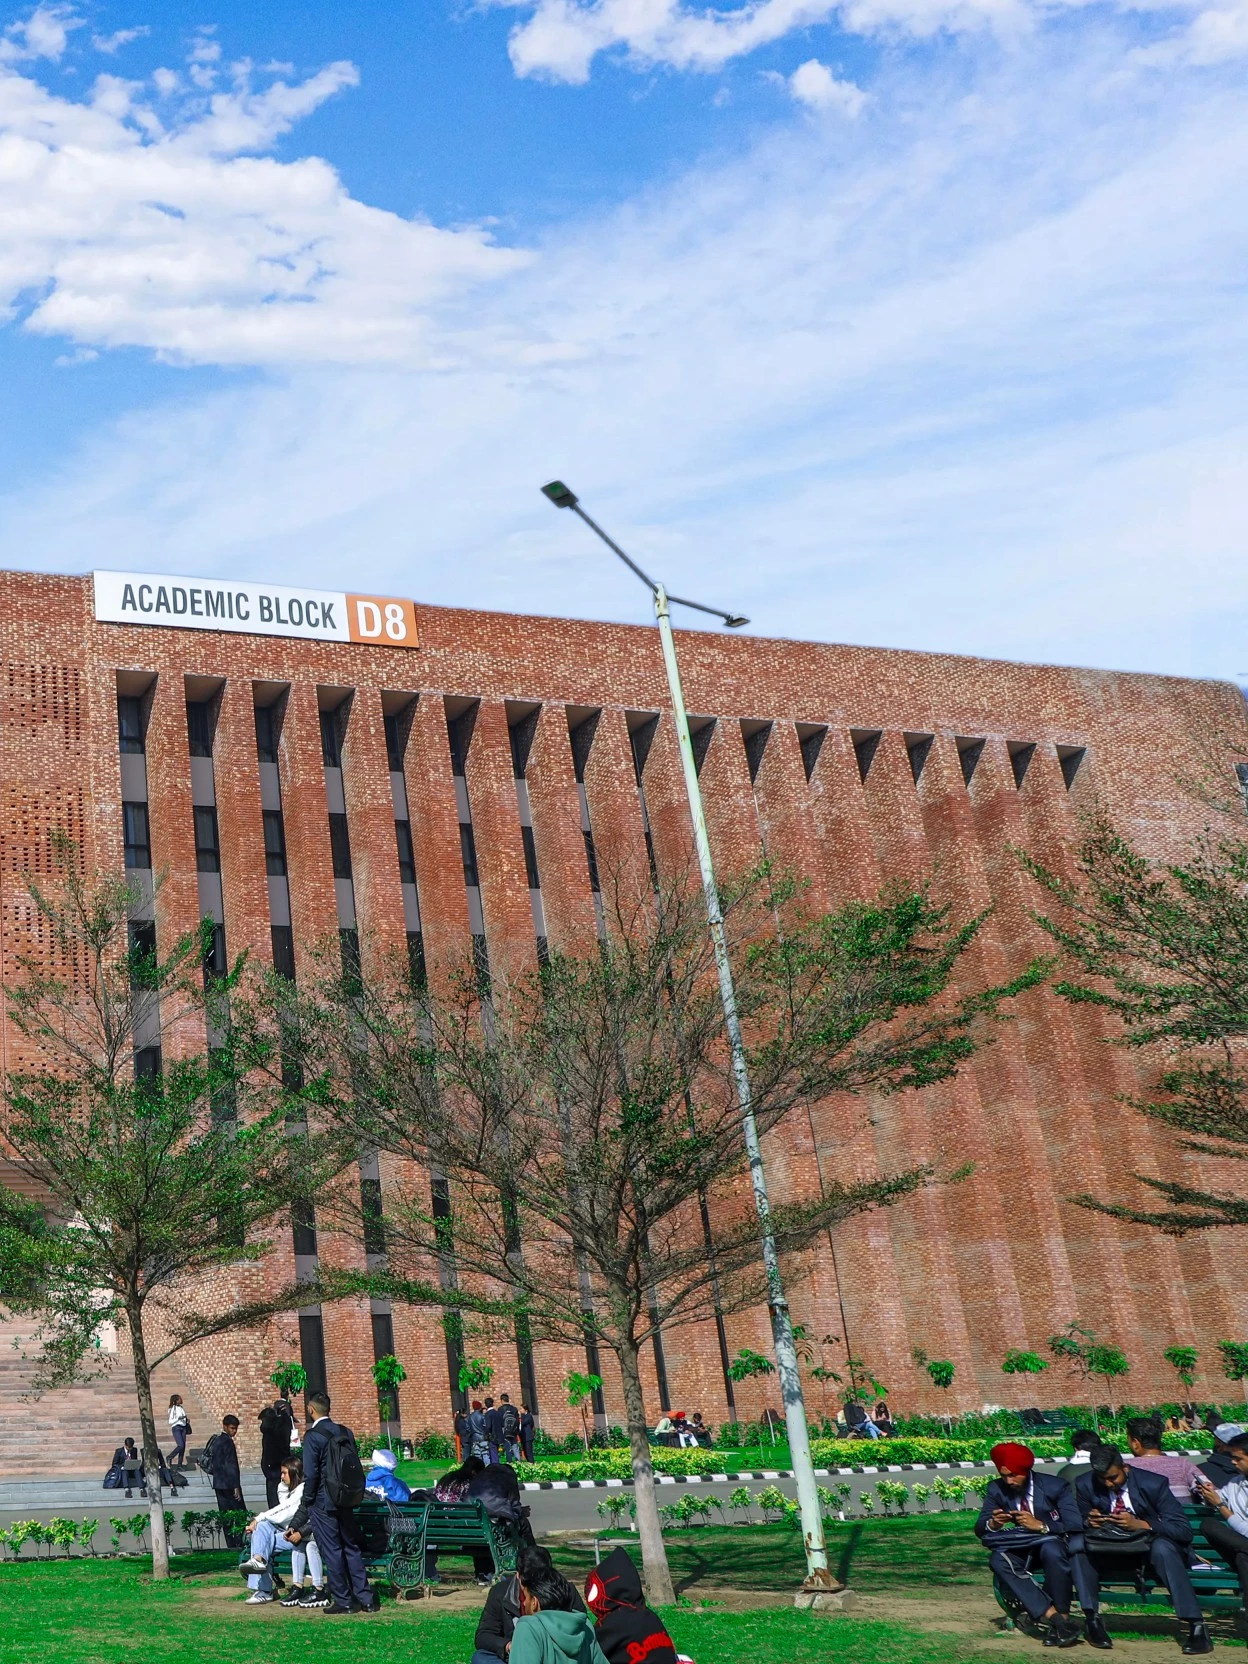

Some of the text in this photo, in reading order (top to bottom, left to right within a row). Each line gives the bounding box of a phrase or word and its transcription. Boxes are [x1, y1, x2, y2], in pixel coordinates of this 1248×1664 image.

[121, 583, 408, 640] ACADEMIC BLOCK D8
